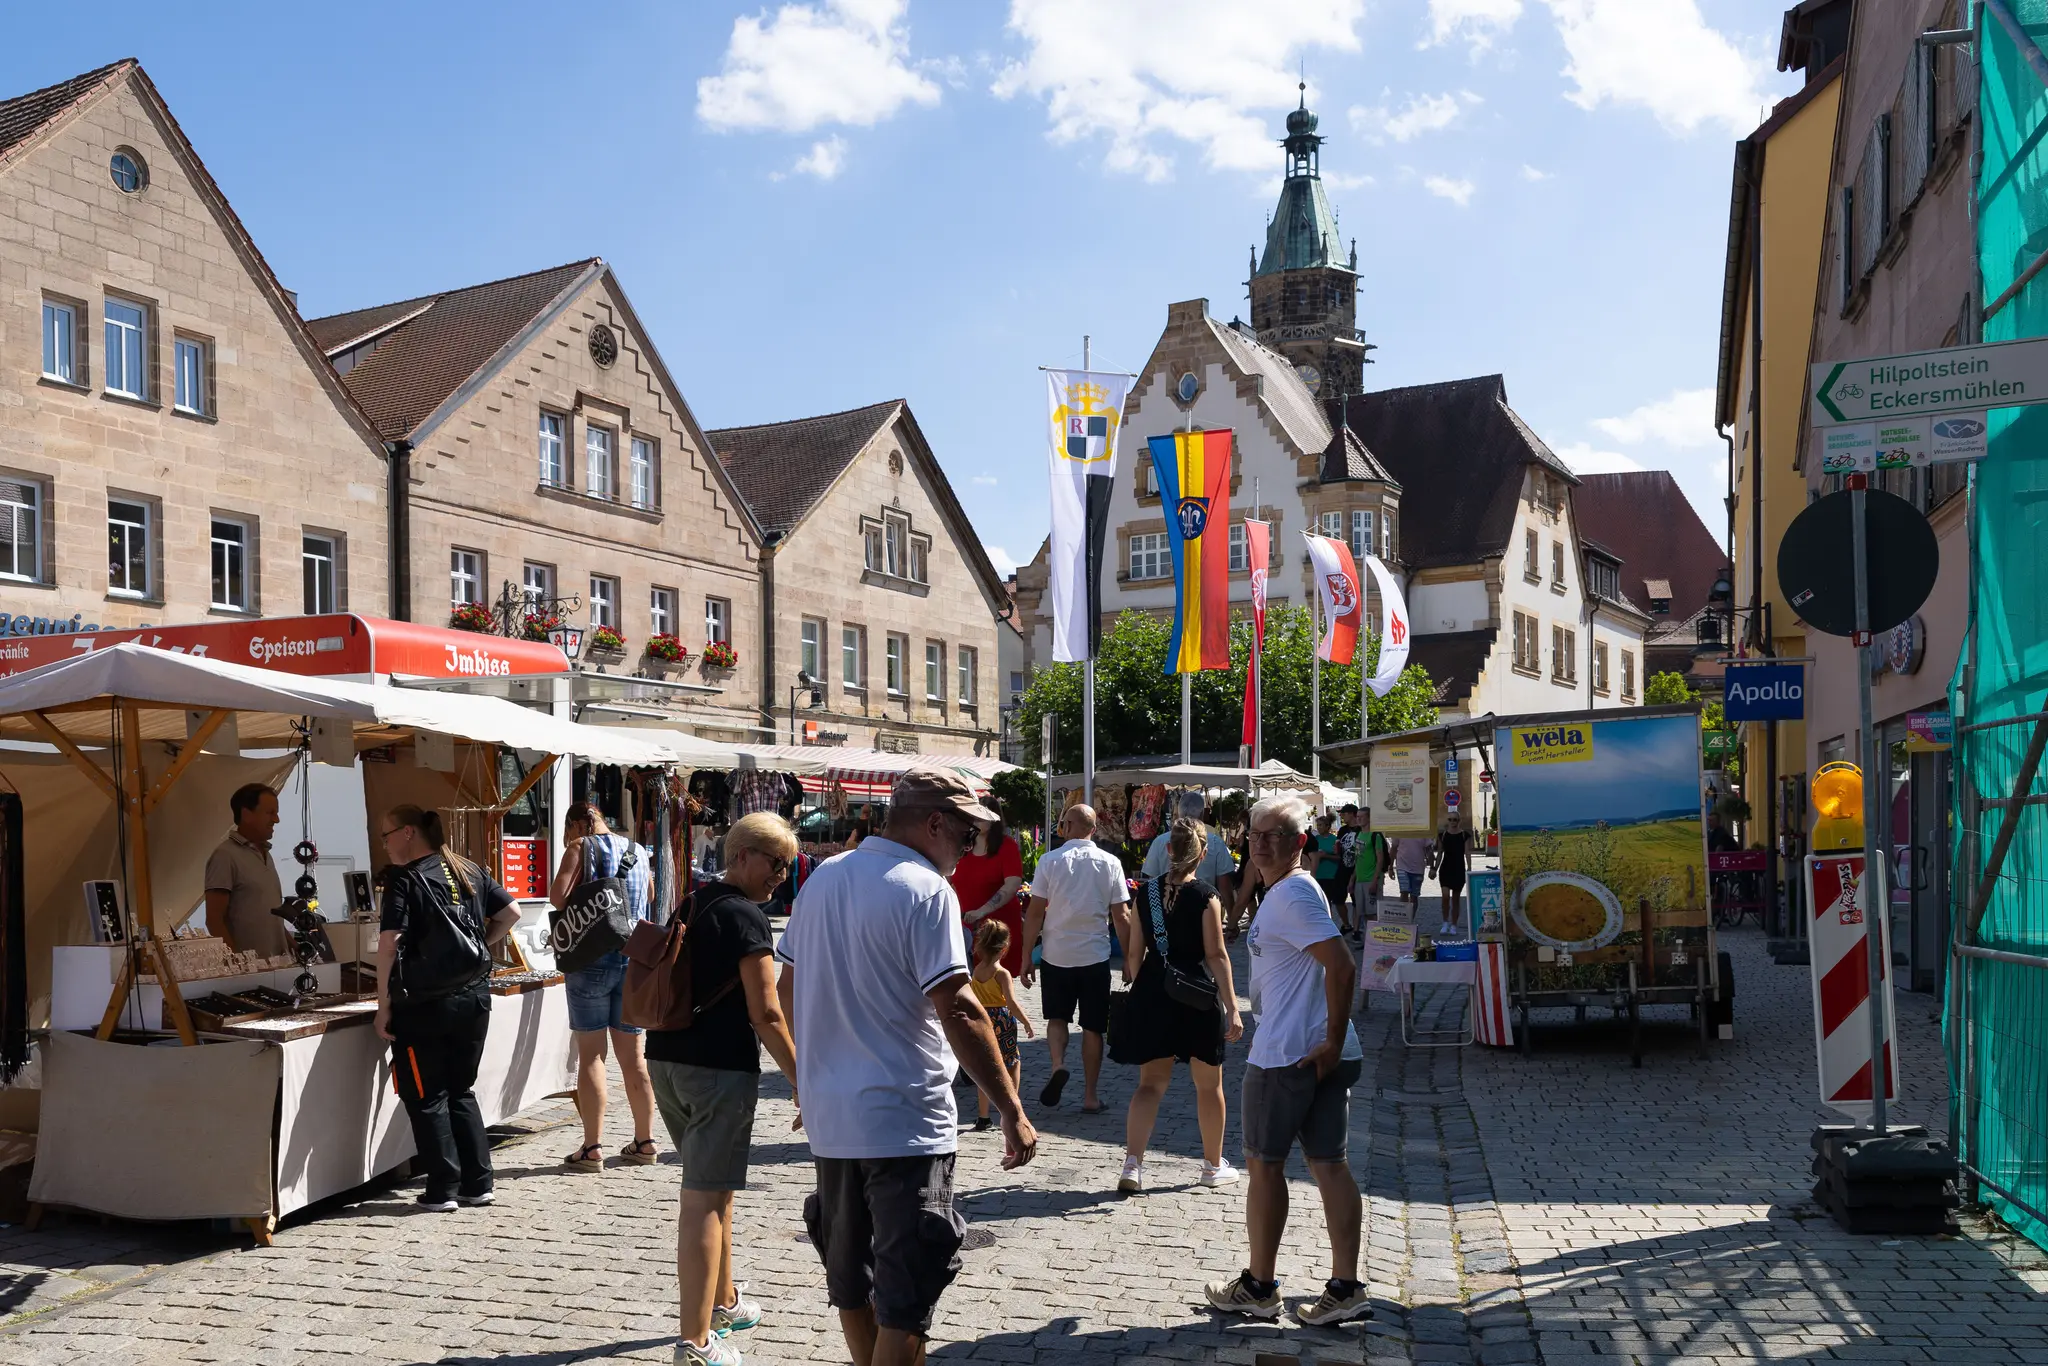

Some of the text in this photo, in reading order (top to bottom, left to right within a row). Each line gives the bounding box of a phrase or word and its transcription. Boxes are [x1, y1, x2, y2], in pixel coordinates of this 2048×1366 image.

[1870, 356, 1989, 387] Hilpoltstein
[1870, 380, 2025, 410] Eckersmühlen
[1070, 418, 1083, 434] R
[249, 635, 316, 664] Speisen
[1728, 681, 1801, 704] Apollo
[1519, 727, 1585, 748] wela
[1521, 748, 1546, 758] Direkt
[1546, 747, 1586, 760] Hersteller
